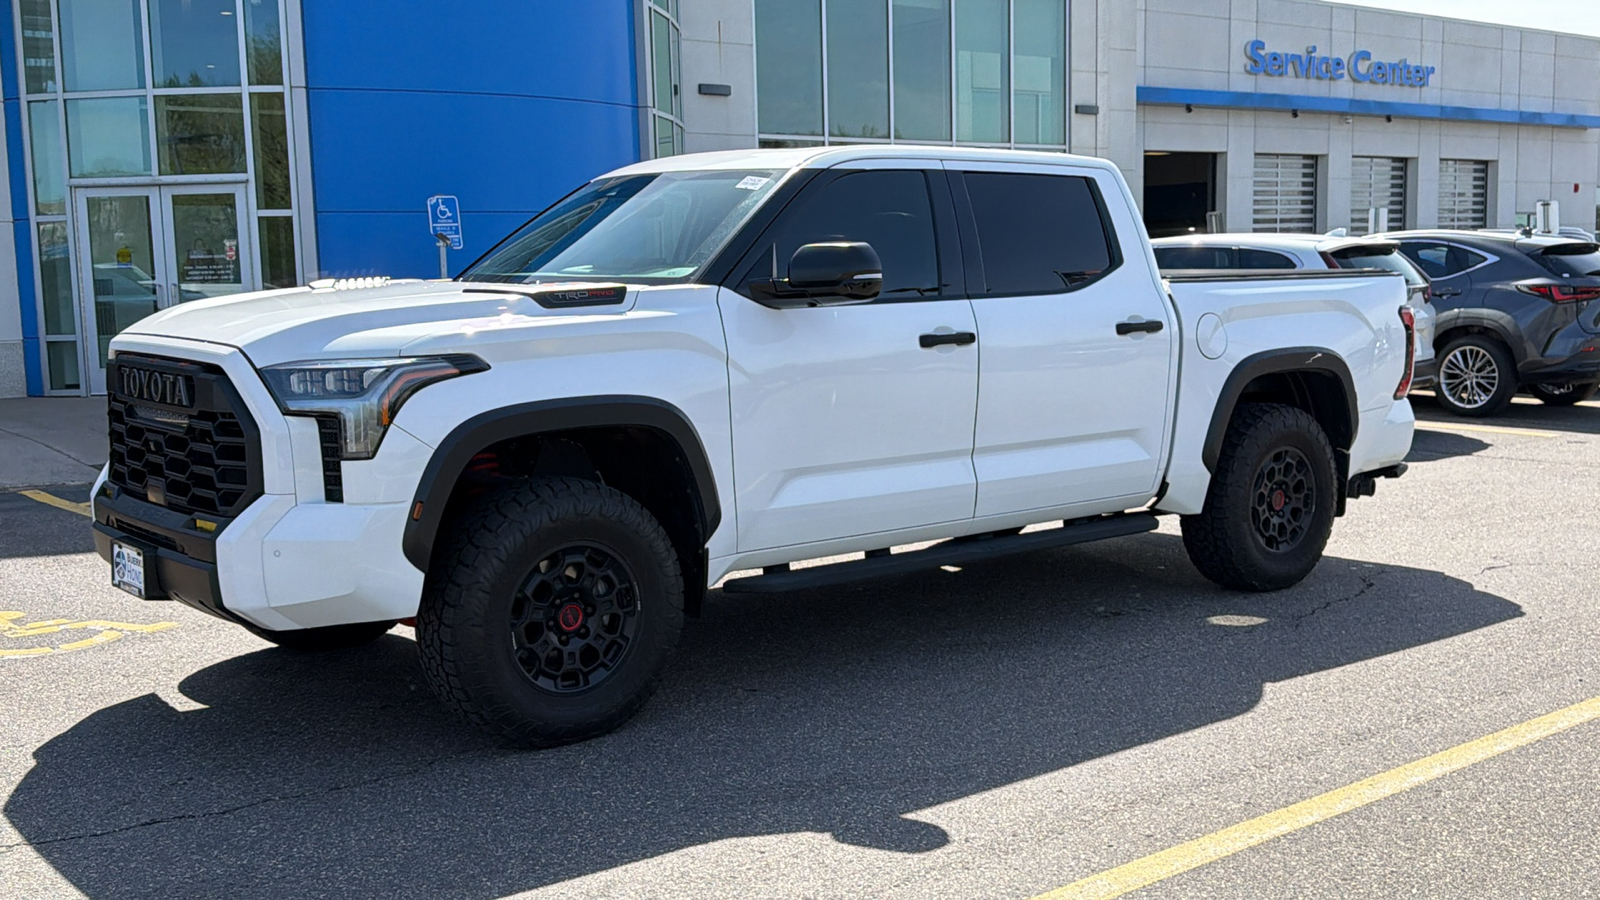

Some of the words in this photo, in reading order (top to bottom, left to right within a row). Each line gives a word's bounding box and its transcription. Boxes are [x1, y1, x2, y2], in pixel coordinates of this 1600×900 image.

[1245, 40, 1345, 80] Service
[1348, 50, 1435, 87] Center
[121, 366, 187, 406] TOYOTA
